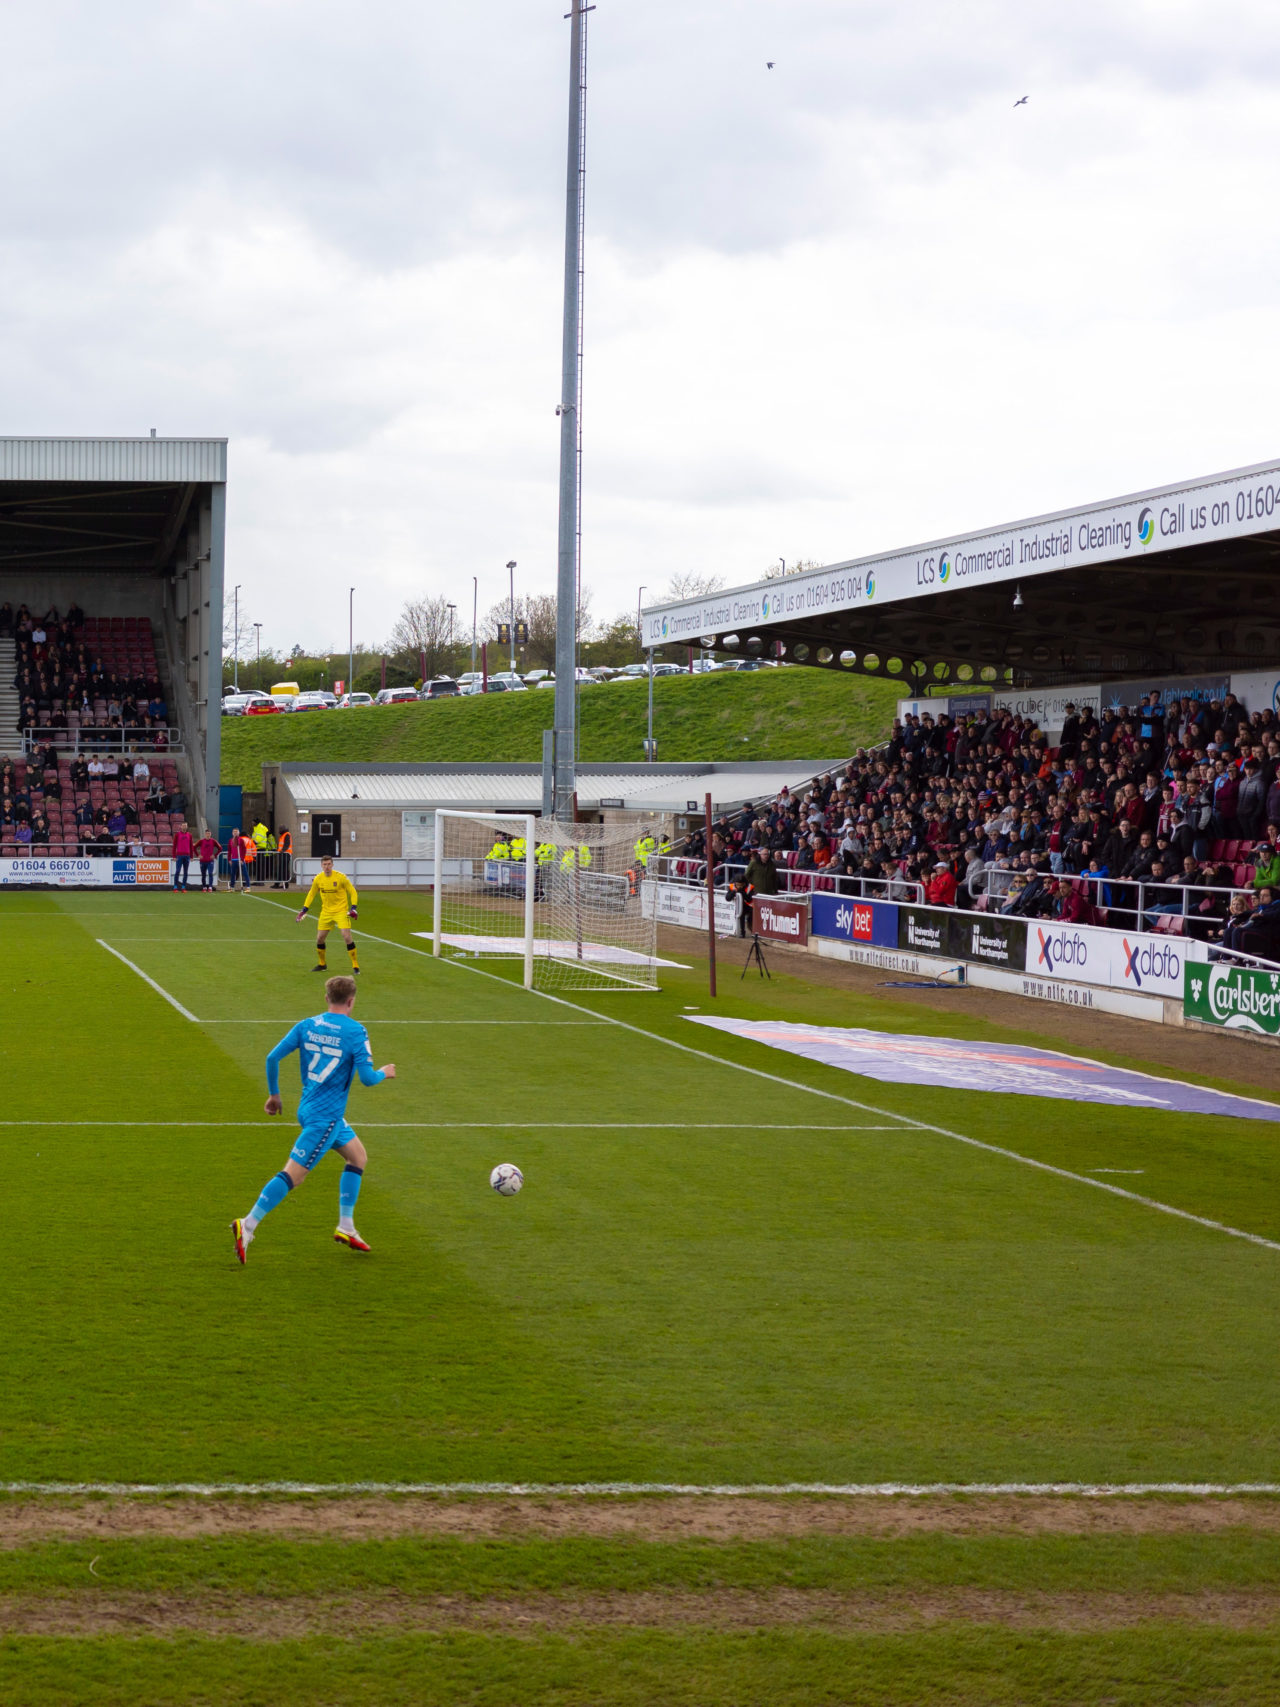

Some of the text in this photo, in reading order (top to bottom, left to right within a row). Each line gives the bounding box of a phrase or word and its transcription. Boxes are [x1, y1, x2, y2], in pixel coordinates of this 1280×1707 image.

[917, 559, 935, 586] LCS
[955, 539, 1014, 577] Commercial
[1019, 526, 1072, 564] Industrial
[1078, 518, 1132, 552] Cleaning
[1160, 503, 1185, 536] Call
[1190, 506, 1207, 529] us
[1212, 501, 1230, 526] on
[650, 577, 862, 639] LCS Commercial Industrial Cleaning Call us on 01604 926 004
[12, 860, 90, 871] 01604 666700
[769, 908, 800, 936] hummel
[835, 904, 871, 935] sky bet
[915, 927, 940, 939] University of
[915, 937, 940, 949] Northampton
[980, 936, 1008, 949] University of
[980, 947, 1008, 960] Northampton
[1053, 931, 1087, 966] dbfb
[1141, 943, 1180, 980] dbfb
[1023, 980, 1093, 1007] www.ntfc.co.uk
[1208, 965, 1280, 1020] Carlsber
[304, 1042, 342, 1083] 27
